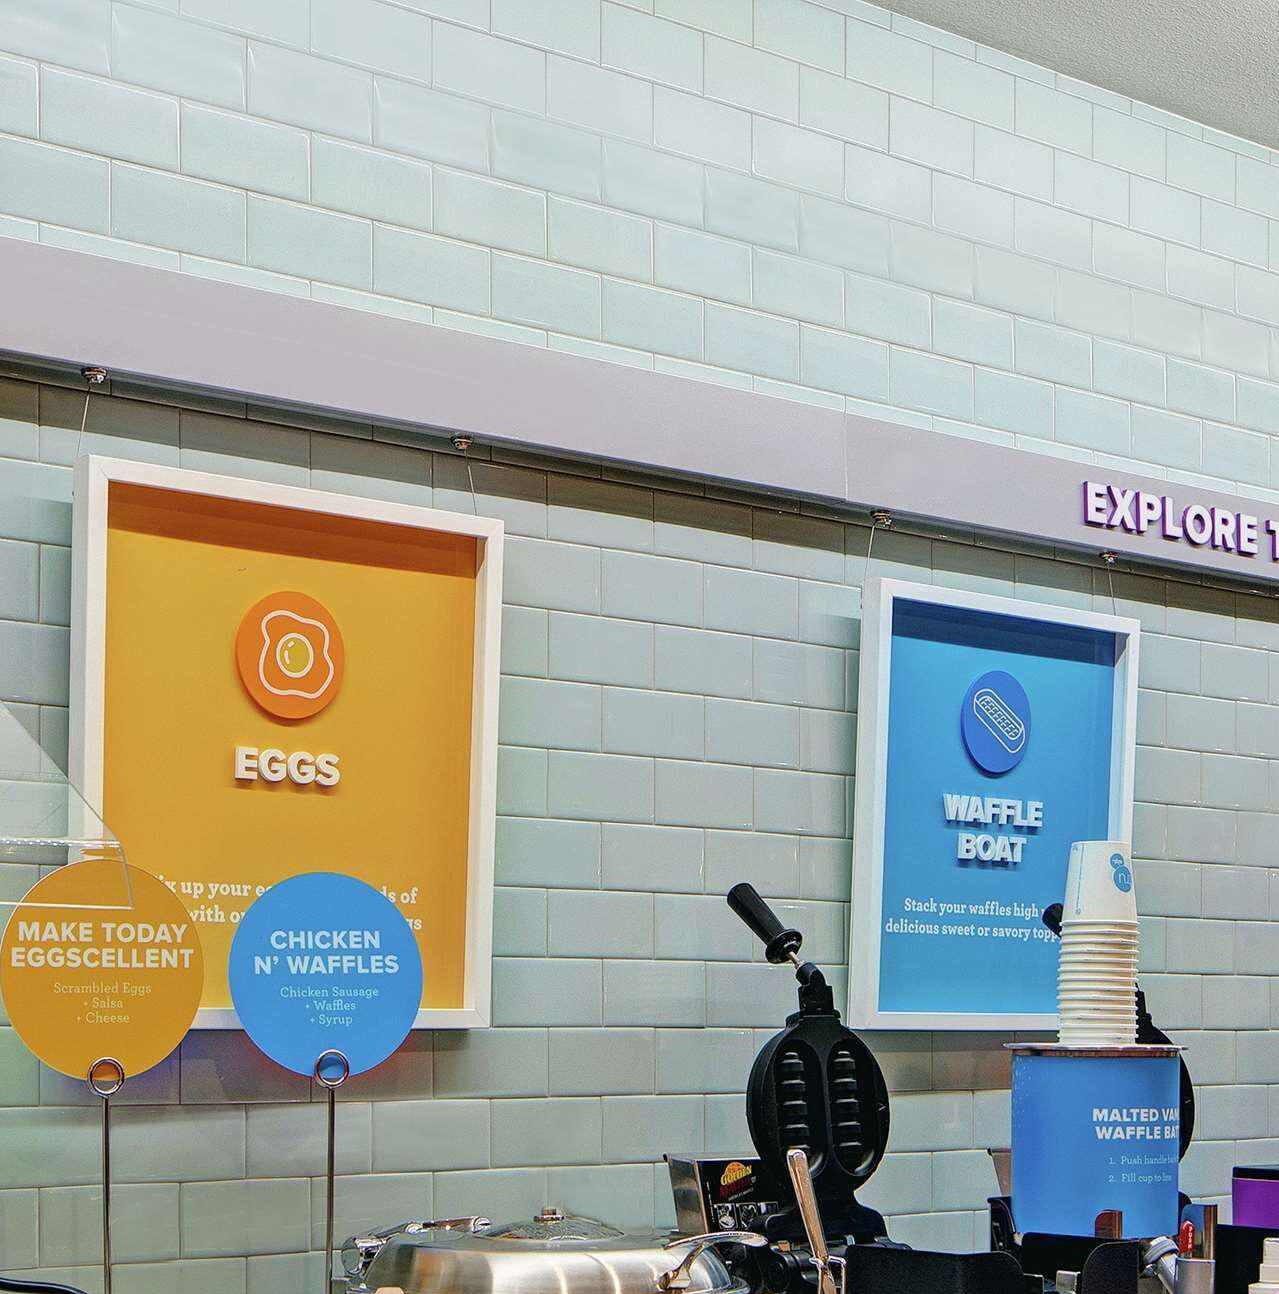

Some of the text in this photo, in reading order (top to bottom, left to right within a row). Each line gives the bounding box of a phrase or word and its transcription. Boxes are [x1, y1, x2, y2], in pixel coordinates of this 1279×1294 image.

[1083, 480, 1259, 555] EXPLORE
[233, 745, 342, 788] EGGS
[942, 793, 1044, 829] WAFFLE
[955, 832, 1028, 864] BOAT
[180, 881, 204, 898] up
[207, 882, 252, 900] your
[400, 887, 419, 904] of
[904, 897, 937, 913] Stack
[939, 902, 967, 916] your
[969, 900, 1012, 917] waffles
[1013, 903, 1040, 921] high
[17, 920, 189, 944] MAKE TODAY
[885, 917, 940, 934] delicious
[941, 923, 976, 937] sweet
[977, 926, 991, 937] or
[992, 926, 1031, 942] savory
[270, 930, 381, 950] CHICKEN
[10, 946, 195, 969] EGGSCELLENT
[287, 954, 400, 975] WAFFLES
[53, 981, 152, 997] Scrambled Eggs
[279, 985, 380, 1001] Chicken Sausage
[92, 997, 124, 1009] Salsa
[314, 999, 357, 1011] Waffles
[85, 1012, 130, 1025] Cheese
[318, 1014, 353, 1027] Syrup
[1092, 1108, 1159, 1123] MALTED
[1095, 1126, 1162, 1140] WAFFLE
[1120, 1156, 1143, 1166] Push
[1121, 1173, 1137, 1183] Fill
[1138, 1176, 1154, 1185] cup
